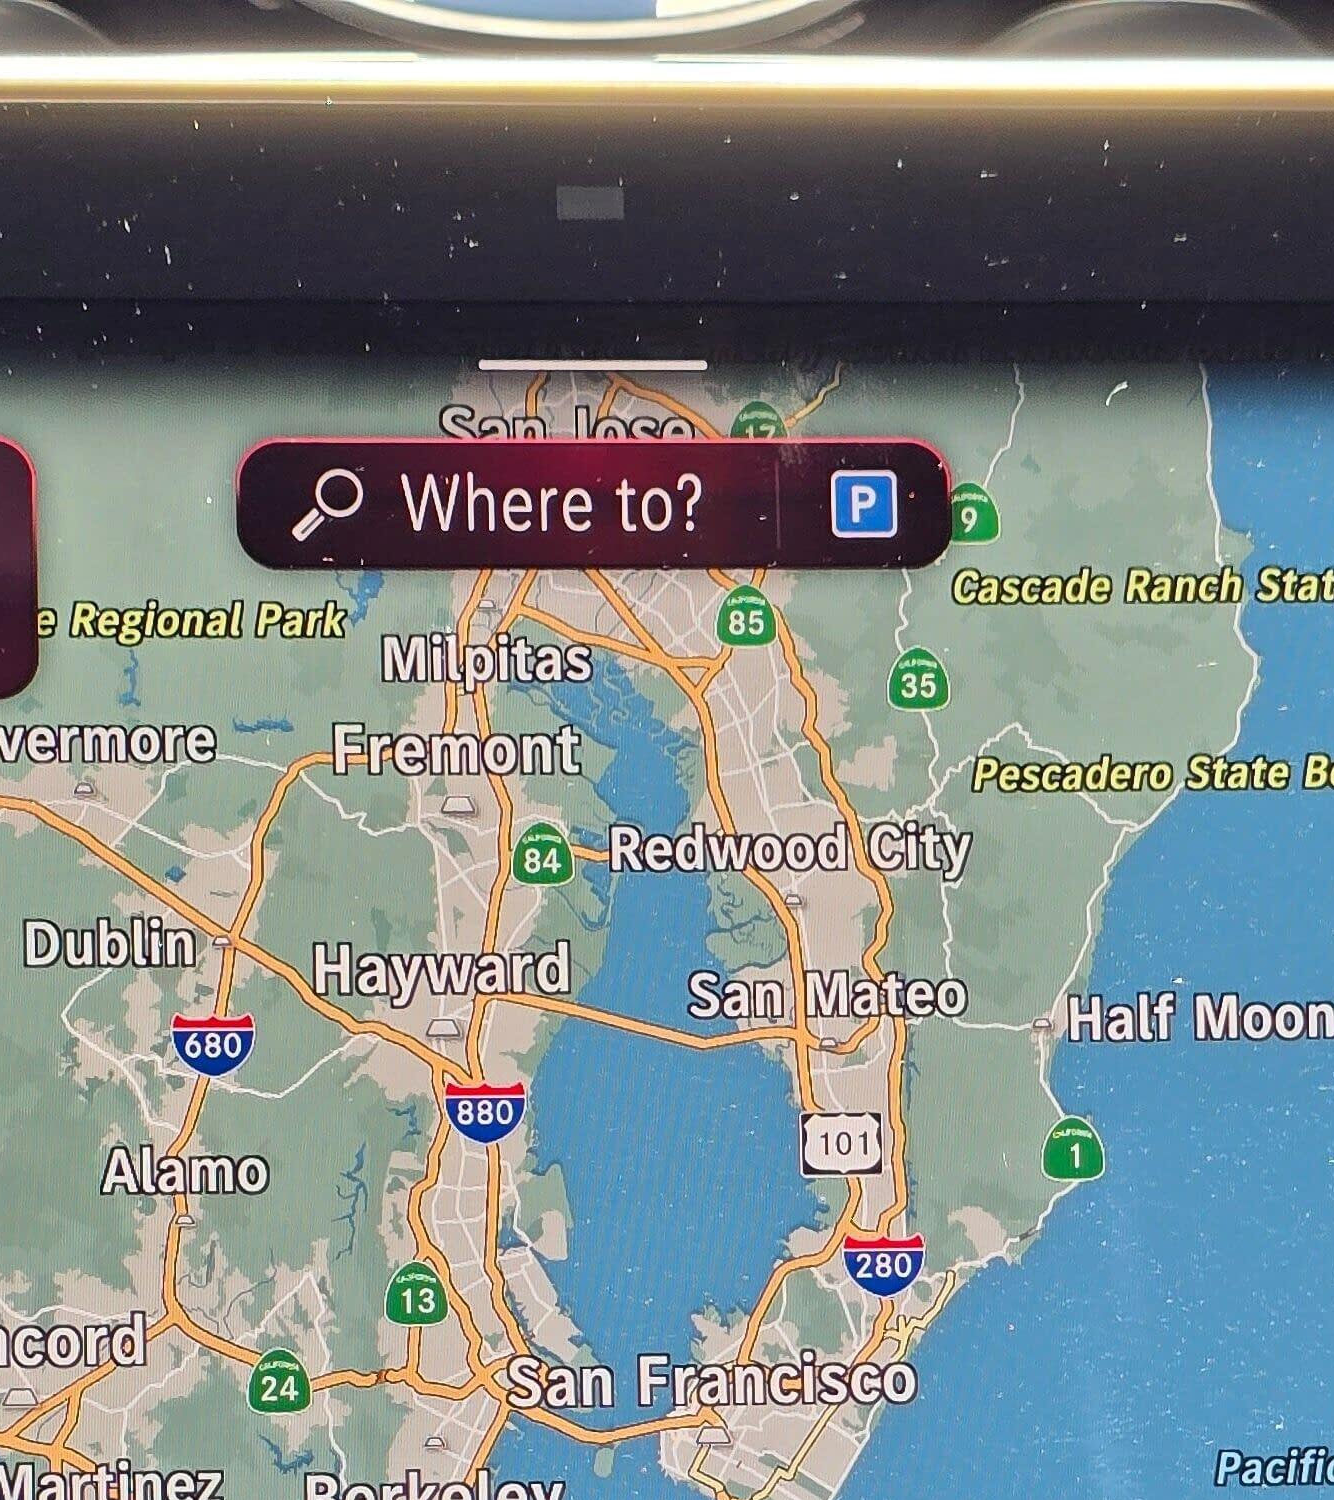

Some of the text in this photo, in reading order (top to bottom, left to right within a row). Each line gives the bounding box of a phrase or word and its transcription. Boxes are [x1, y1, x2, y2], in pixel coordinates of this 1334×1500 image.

[401, 472, 703, 532] Where to?
[960, 506, 978, 533] 9
[952, 568, 1112, 604] Cascade
[1125, 568, 1243, 603] Ranch
[70, 599, 243, 645] Regional
[256, 600, 346, 637] Park
[728, 609, 765, 636] 85
[382, 634, 593, 690] Milpitas
[900, 672, 937, 699] 35
[333, 724, 581, 775] Fremont
[973, 756, 1173, 792] Pescadero
[1186, 756, 1291, 791] State
[523, 847, 562, 875] 84
[610, 823, 972, 881] Redwood City
[24, 919, 196, 968] Dublin
[313, 941, 571, 1006] Hayward
[688, 971, 968, 1019] San Mateo
[1069, 993, 1175, 1042] Half
[183, 1031, 242, 1059] 680
[455, 1099, 515, 1127] 880
[818, 1130, 871, 1157] 101
[1069, 1142, 1082, 1170] 1
[102, 1148, 268, 1196] Alamo
[853, 1252, 914, 1280] 280
[401, 1287, 436, 1315] 13
[260, 1375, 300, 1402] 24
[507, 1351, 918, 1409] San Francisco
